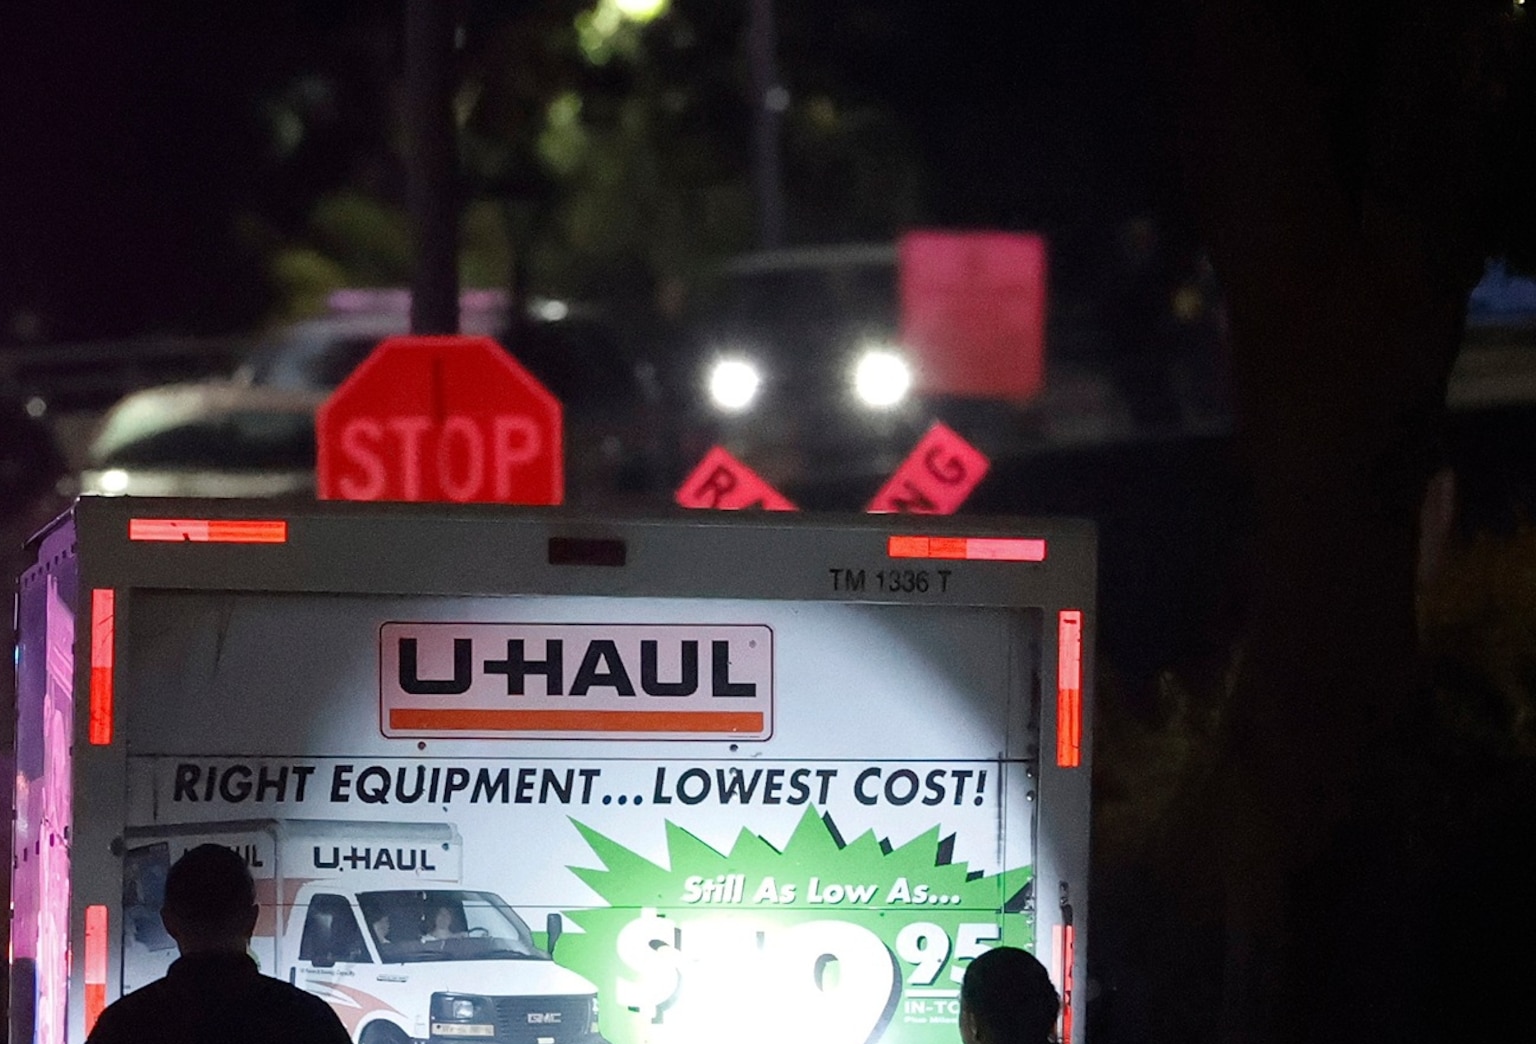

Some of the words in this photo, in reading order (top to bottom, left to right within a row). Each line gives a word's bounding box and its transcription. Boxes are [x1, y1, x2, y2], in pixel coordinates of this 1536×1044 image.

[339, 415, 542, 501] STOP
[829, 568, 865, 592] TM
[876, 570, 930, 593] 1336
[936, 570, 953, 592] T
[398, 637, 757, 698] U-HAUL
[173, 763, 316, 803] RIGHT
[854, 767, 988, 807] COST!
[681, 874, 747, 905] Still
[752, 876, 796, 904] As
[805, 877, 880, 905] Low
